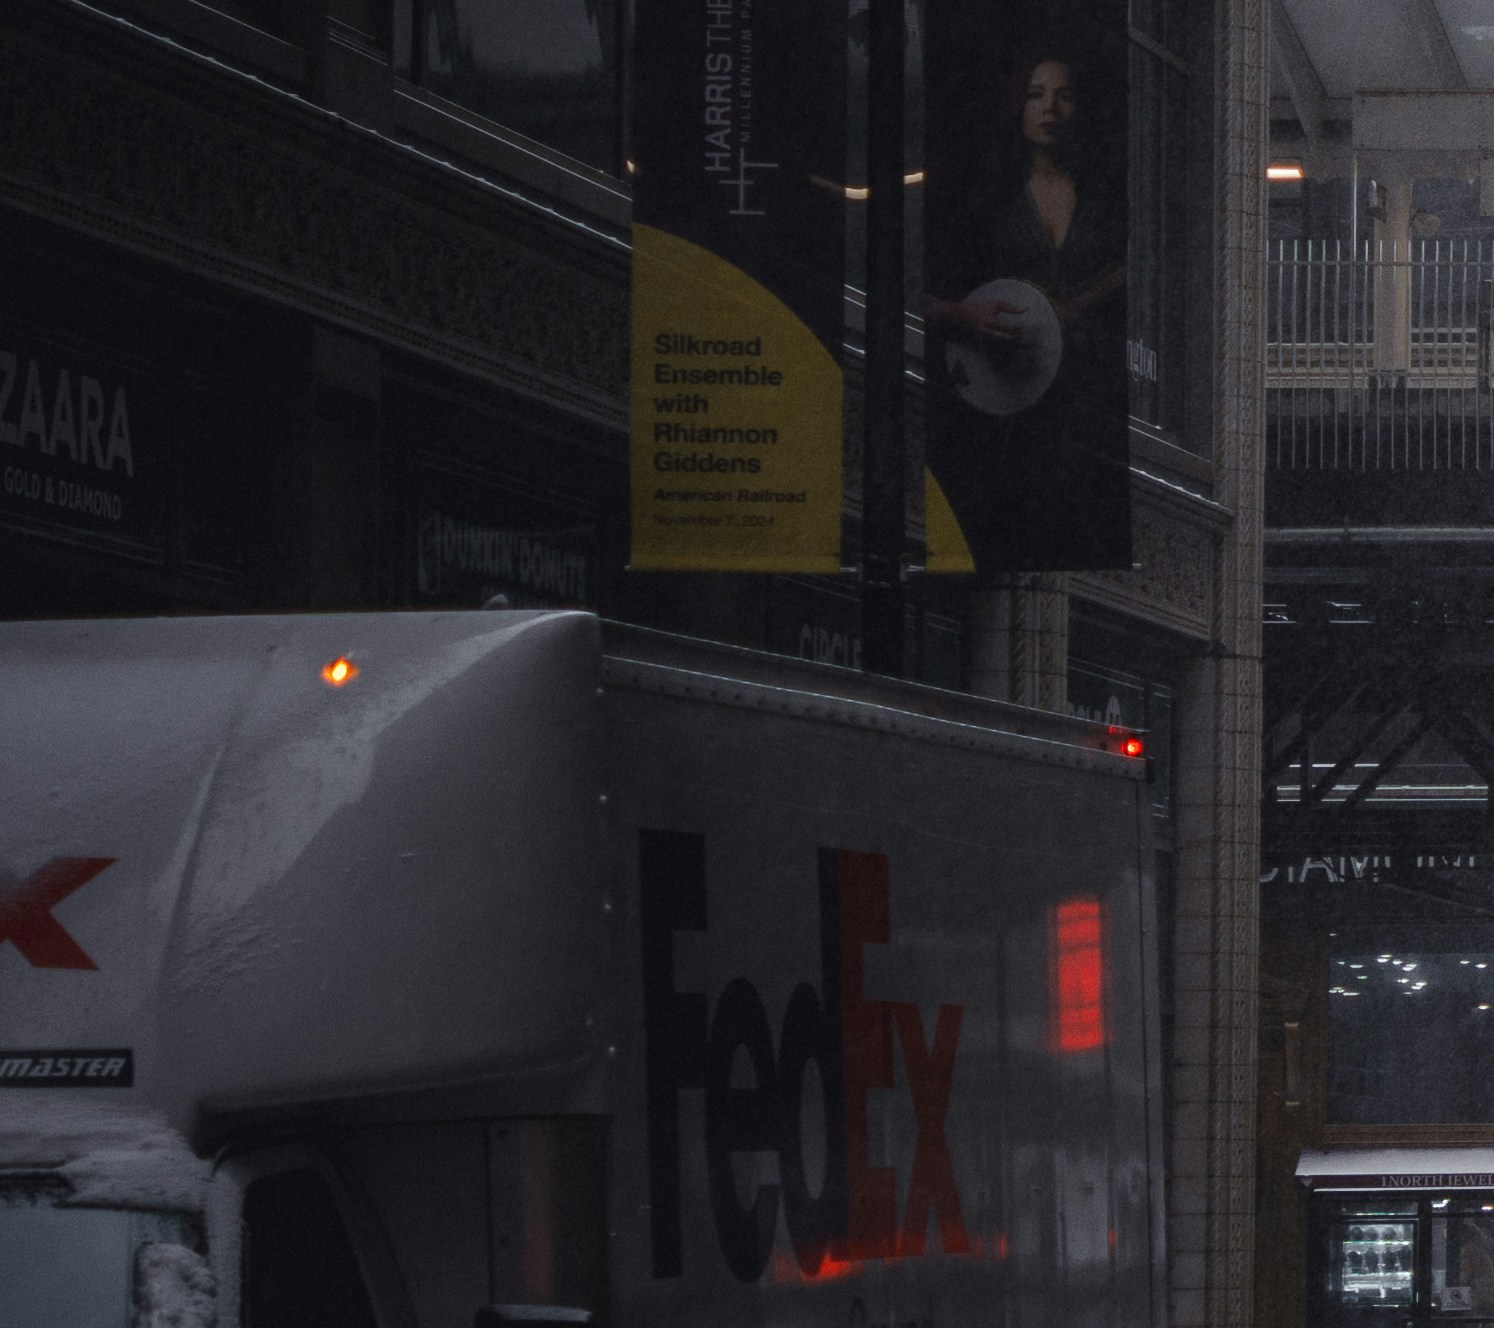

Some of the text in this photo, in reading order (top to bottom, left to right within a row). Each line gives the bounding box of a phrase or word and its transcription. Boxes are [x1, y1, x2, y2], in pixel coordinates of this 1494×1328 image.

[739, 28, 754, 144] MILLENNIUM
[704, 52, 732, 172] HARRIS
[655, 333, 762, 357] Silkroad
[655, 363, 784, 387] Ensemble
[654, 394, 709, 414] with
[655, 422, 779, 445] Rhiannon
[654, 451, 761, 474] Giddens
[4, 465, 122, 521] GOLD & DIAMOND
[655, 488, 807, 504] American Railroad
[640, 827, 972, 1283] FedEx
